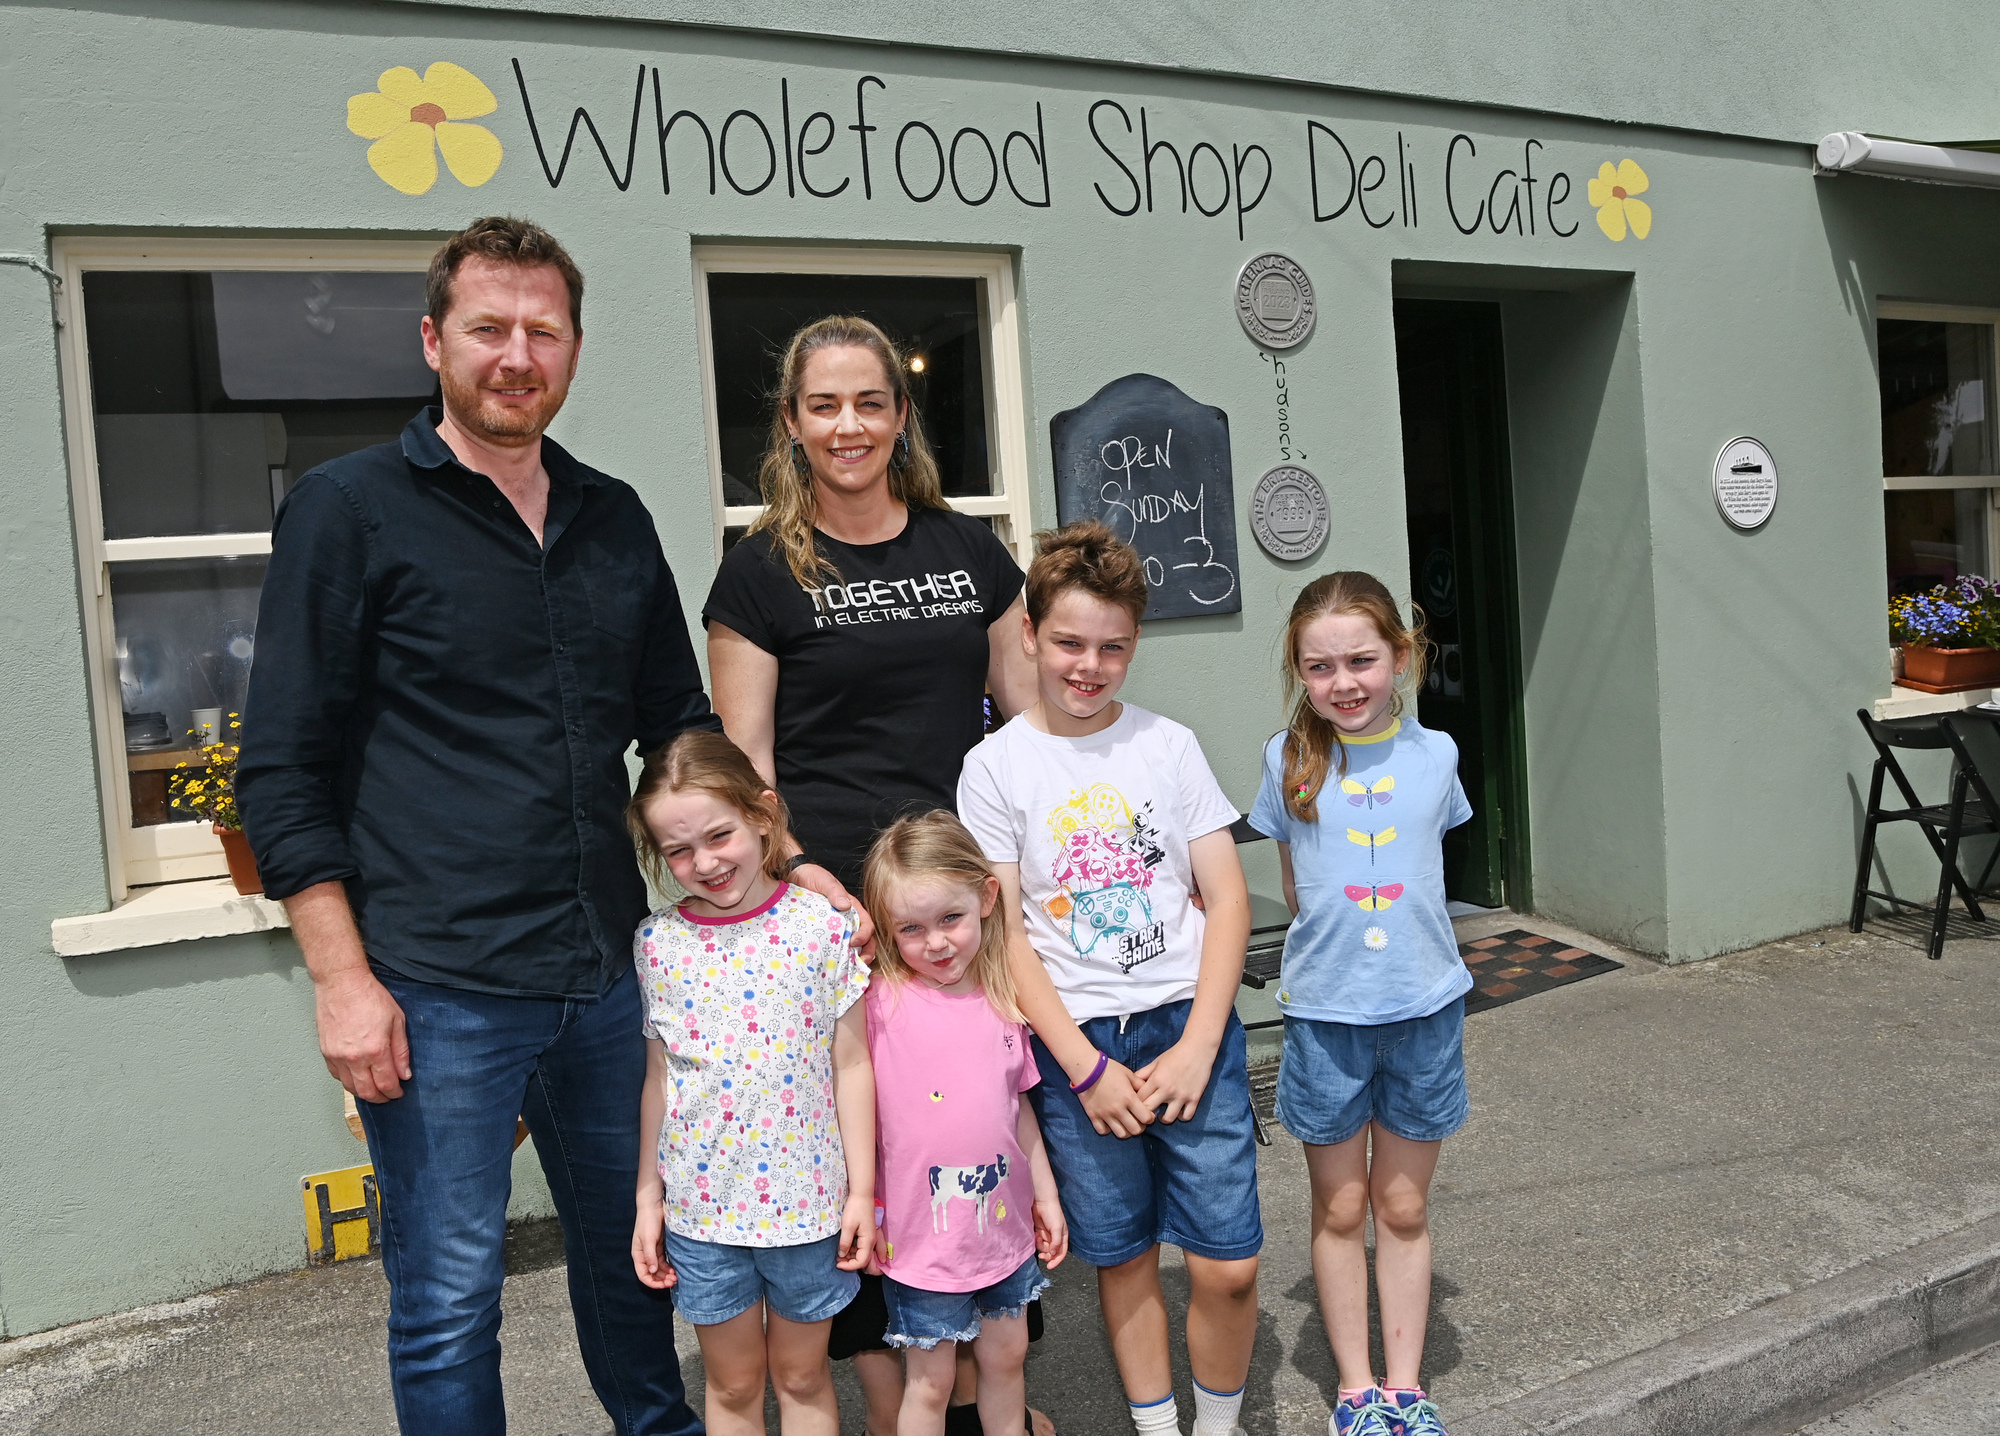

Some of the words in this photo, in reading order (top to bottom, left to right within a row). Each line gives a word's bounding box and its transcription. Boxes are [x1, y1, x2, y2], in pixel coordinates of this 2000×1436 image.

[511, 57, 1051, 207] Wholefood
[1088, 99, 1273, 241] Shop
[1308, 119, 1418, 230] Deli
[1445, 133, 1580, 238] Cafe
[1273, 355, 1291, 460] hudsons
[1101, 428, 1172, 490] OPEN
[802, 569, 977, 612] TOGETHER
[814, 614, 832, 629] IN
[835, 606, 919, 626] ELECTRIC
[921, 599, 984, 619] DREAMS
[1119, 920, 1163, 954] START
[1122, 935, 1166, 968] GAME
[315, 1174, 381, 1256] H
